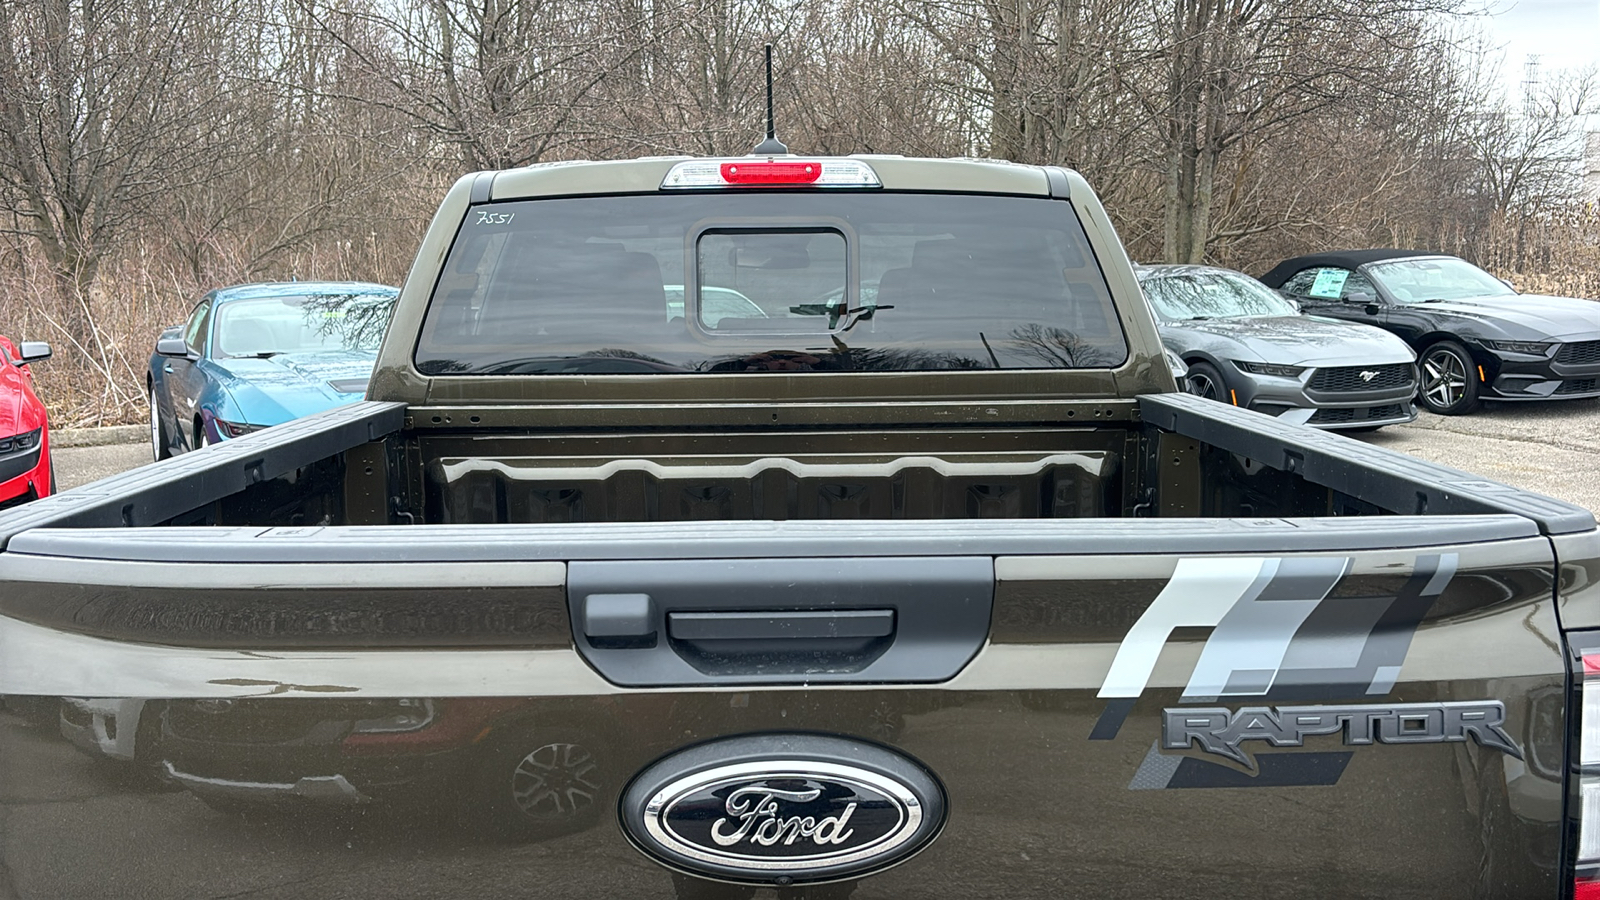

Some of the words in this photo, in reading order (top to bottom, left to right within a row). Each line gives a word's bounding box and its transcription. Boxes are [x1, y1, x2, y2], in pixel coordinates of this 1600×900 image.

[476, 211, 515, 225] 7551
[1162, 700, 1525, 771] RAPTOR
[711, 786, 858, 846] Ford
